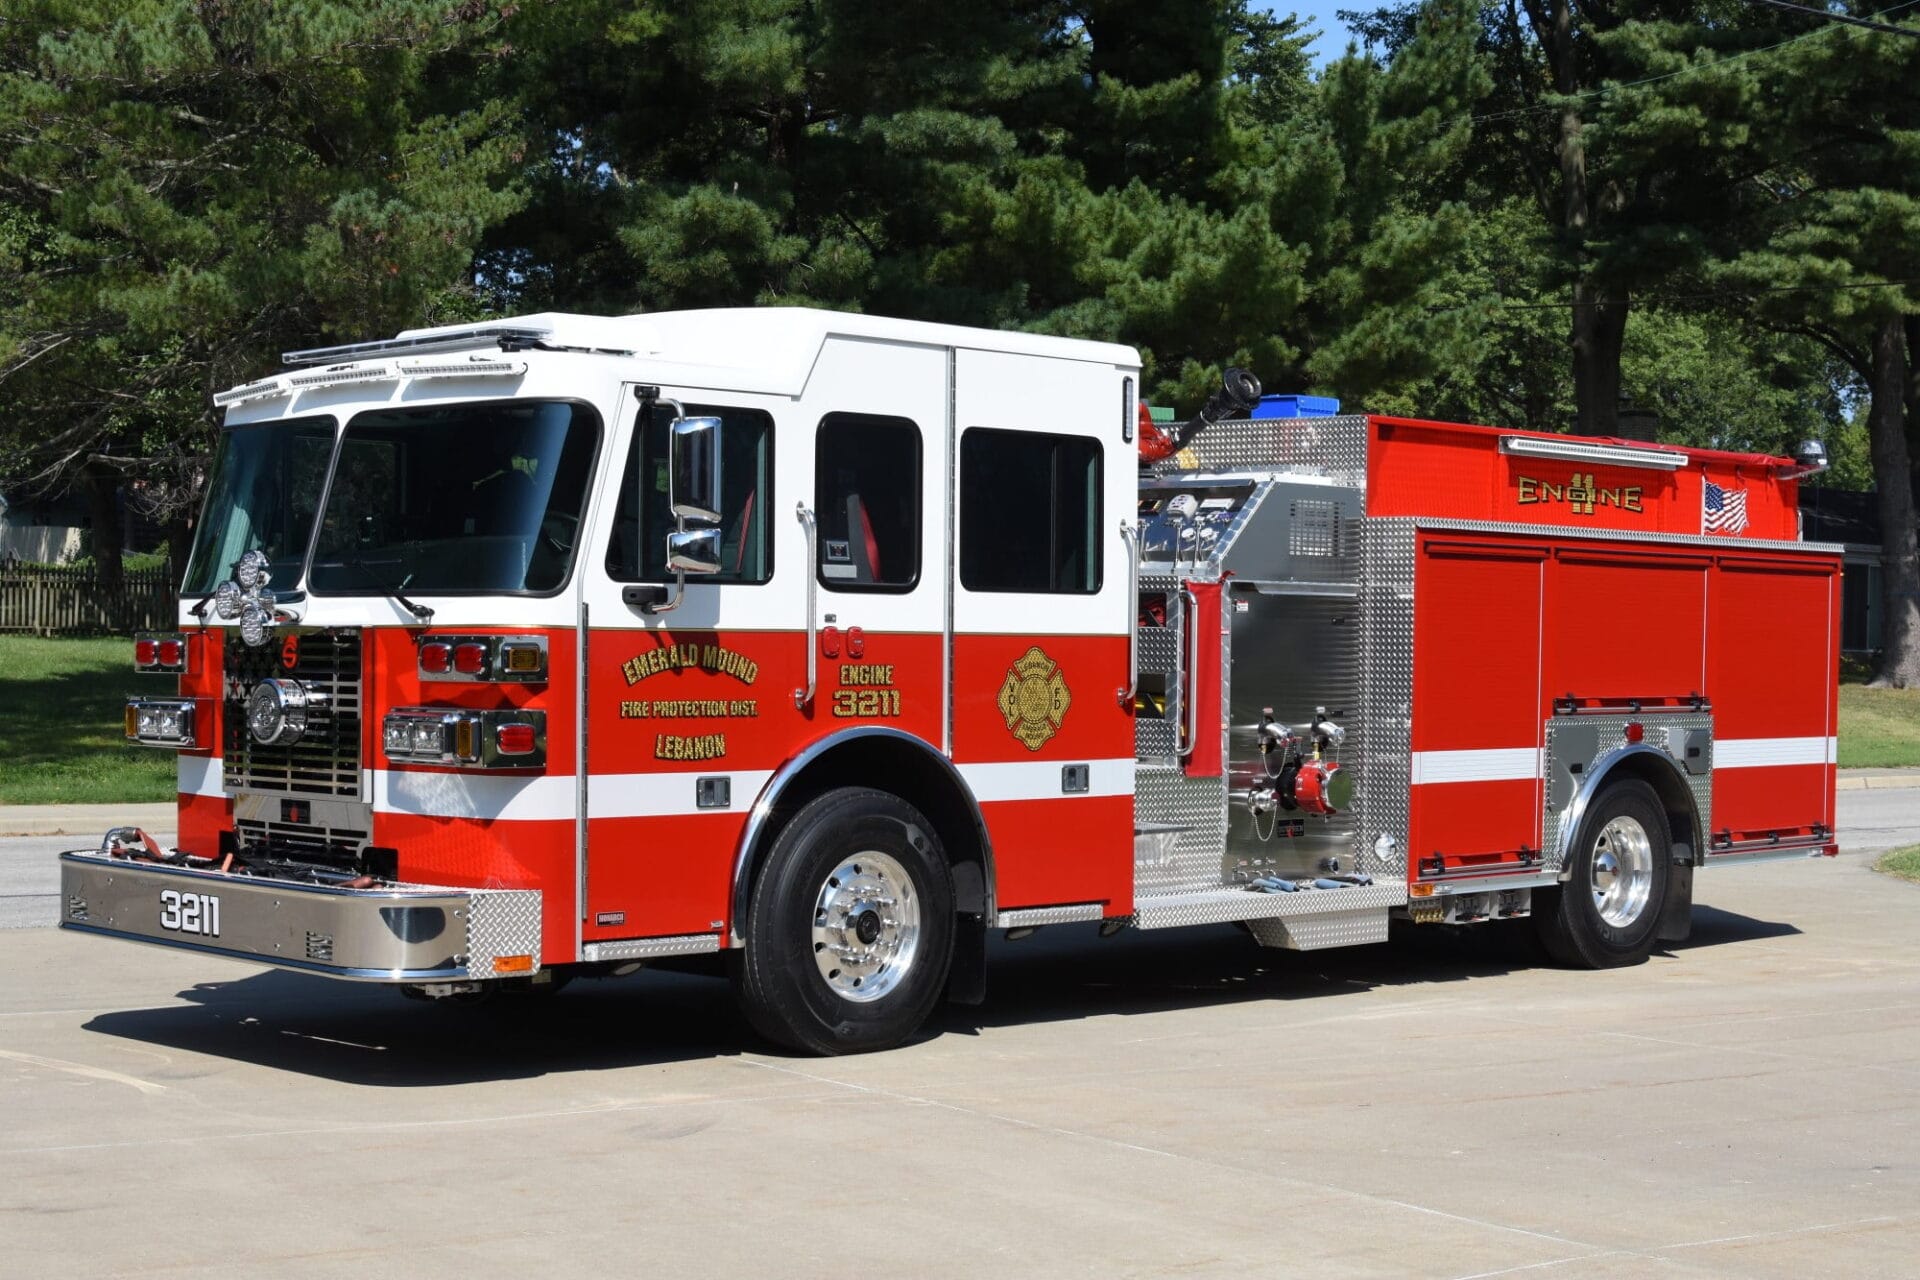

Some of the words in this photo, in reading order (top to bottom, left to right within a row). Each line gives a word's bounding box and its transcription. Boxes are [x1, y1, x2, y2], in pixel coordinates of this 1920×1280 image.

[1518, 475, 1643, 513] ENGINE
[622, 643, 699, 686] EMERALD
[702, 644, 758, 685] MOUND
[839, 663, 894, 686] ENGINE
[620, 700, 649, 718] FIRE
[652, 700, 728, 718] PROTECTION
[730, 700, 758, 717] DIST.
[832, 689, 901, 717] 3211
[654, 732, 726, 761] LEBANON
[160, 888, 220, 938] 3211
